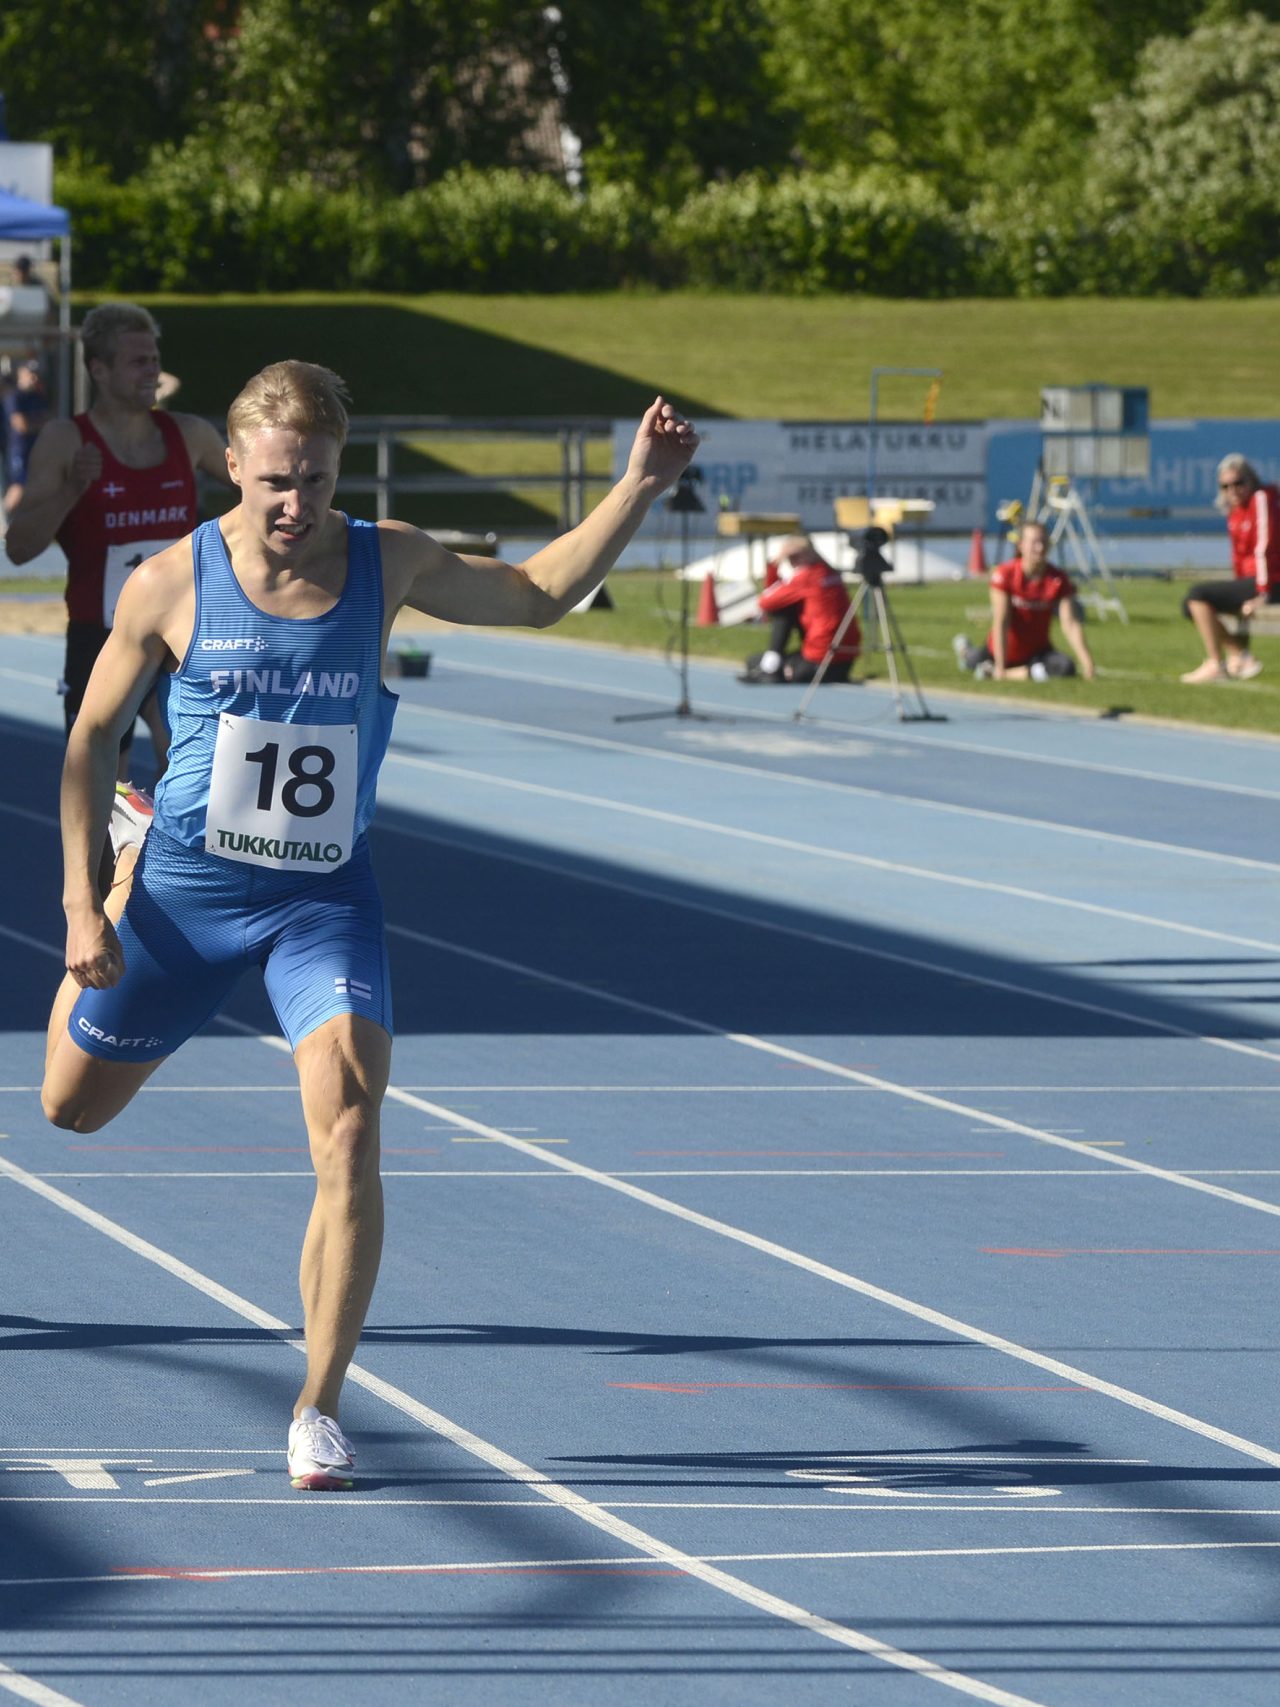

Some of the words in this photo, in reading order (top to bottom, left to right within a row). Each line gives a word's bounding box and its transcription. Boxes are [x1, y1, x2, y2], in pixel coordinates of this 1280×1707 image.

[790, 430, 967, 451] HELATUKKU
[105, 506, 187, 528] DENMARK
[201, 638, 254, 651] CRAFT
[210, 670, 360, 698] FINLAND
[245, 742, 336, 818] 18
[78, 1017, 145, 1048] CRAFT
